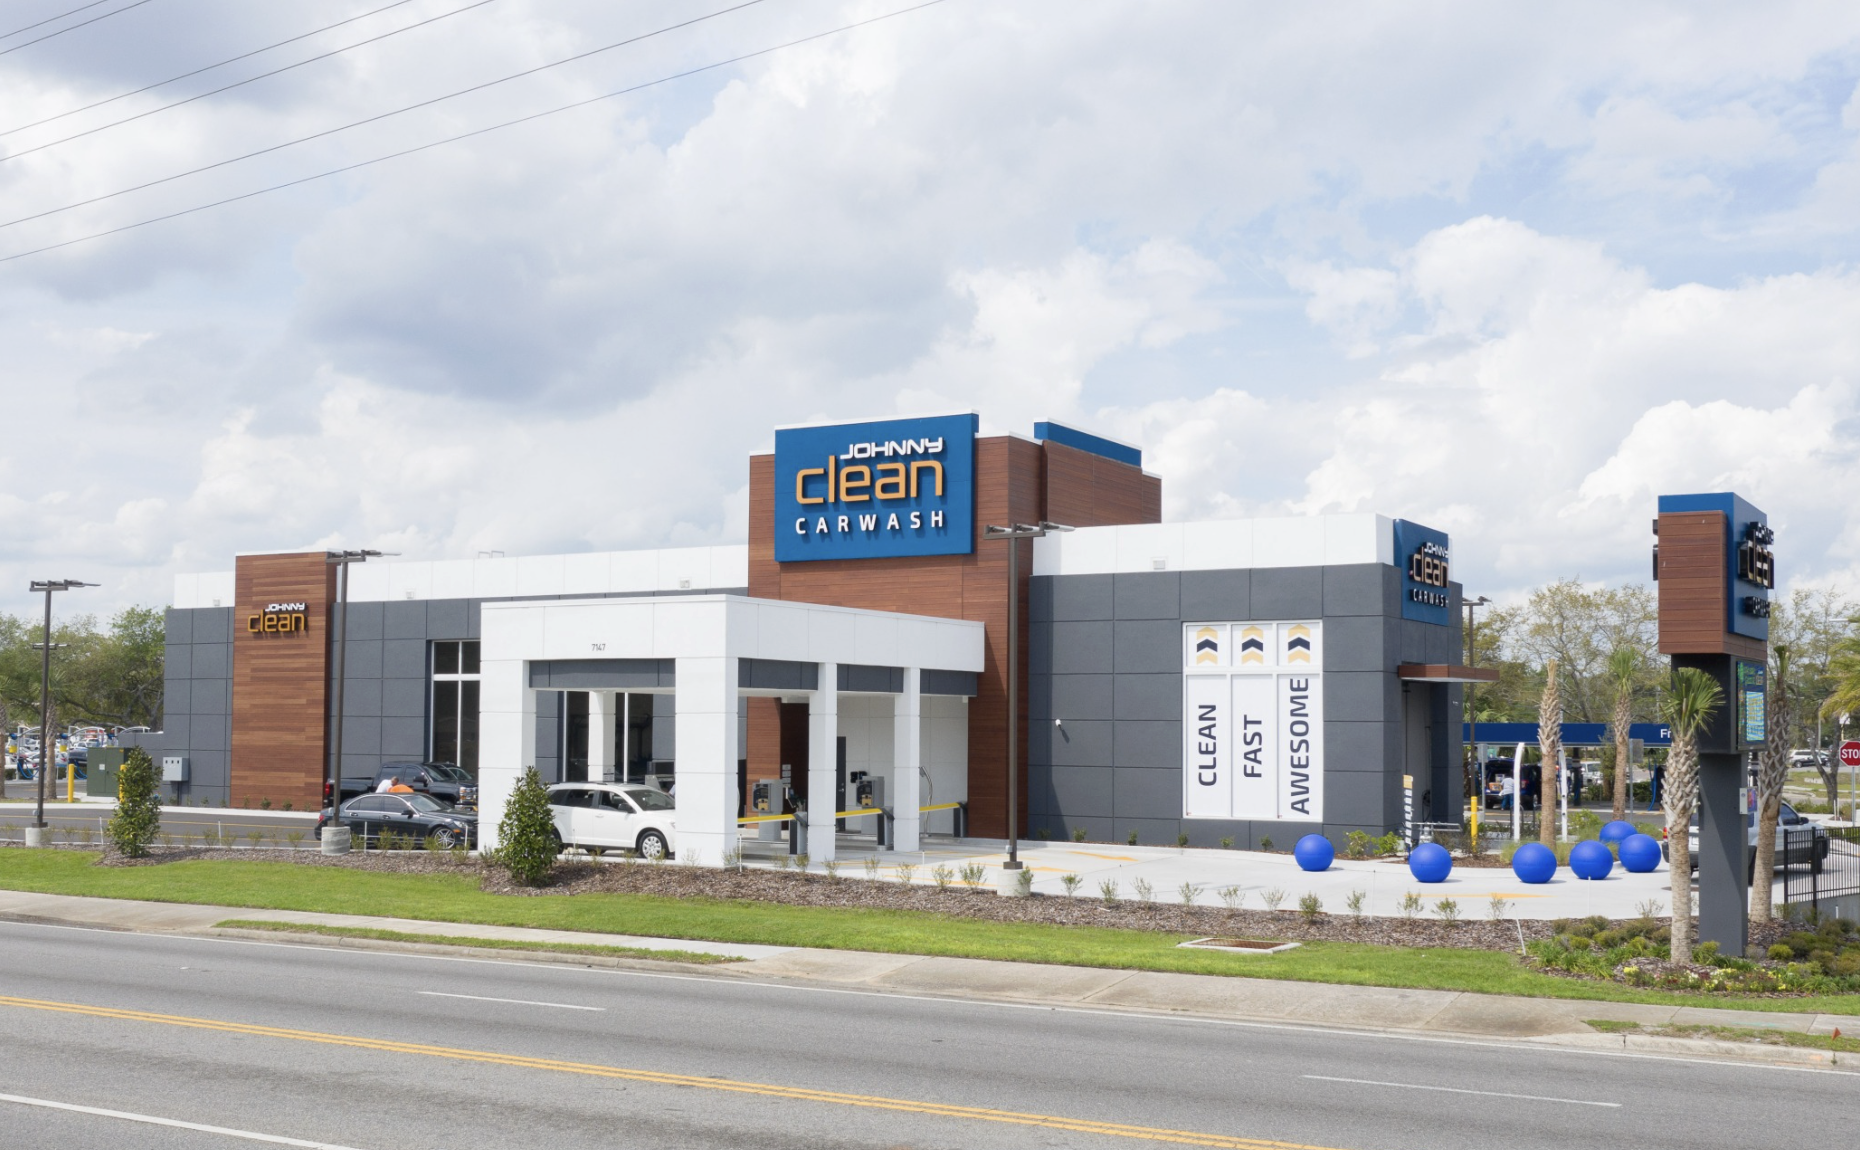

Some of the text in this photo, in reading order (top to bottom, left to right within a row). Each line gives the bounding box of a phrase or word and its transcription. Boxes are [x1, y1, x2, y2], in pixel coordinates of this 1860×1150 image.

[840, 437, 943, 460] JOHNNY
[796, 455, 943, 504] clean
[795, 510, 943, 535] CARWASH
[1413, 546, 1448, 588] clean
[265, 602, 305, 612] JOHNNY
[247, 609, 305, 632] clean
[591, 643, 606, 651] 7147
[1198, 704, 1217, 787] CLEAN
[1243, 714, 1262, 778] FAST
[1290, 678, 1310, 815] AWESOME
[1841, 748, 1860, 759] STO
